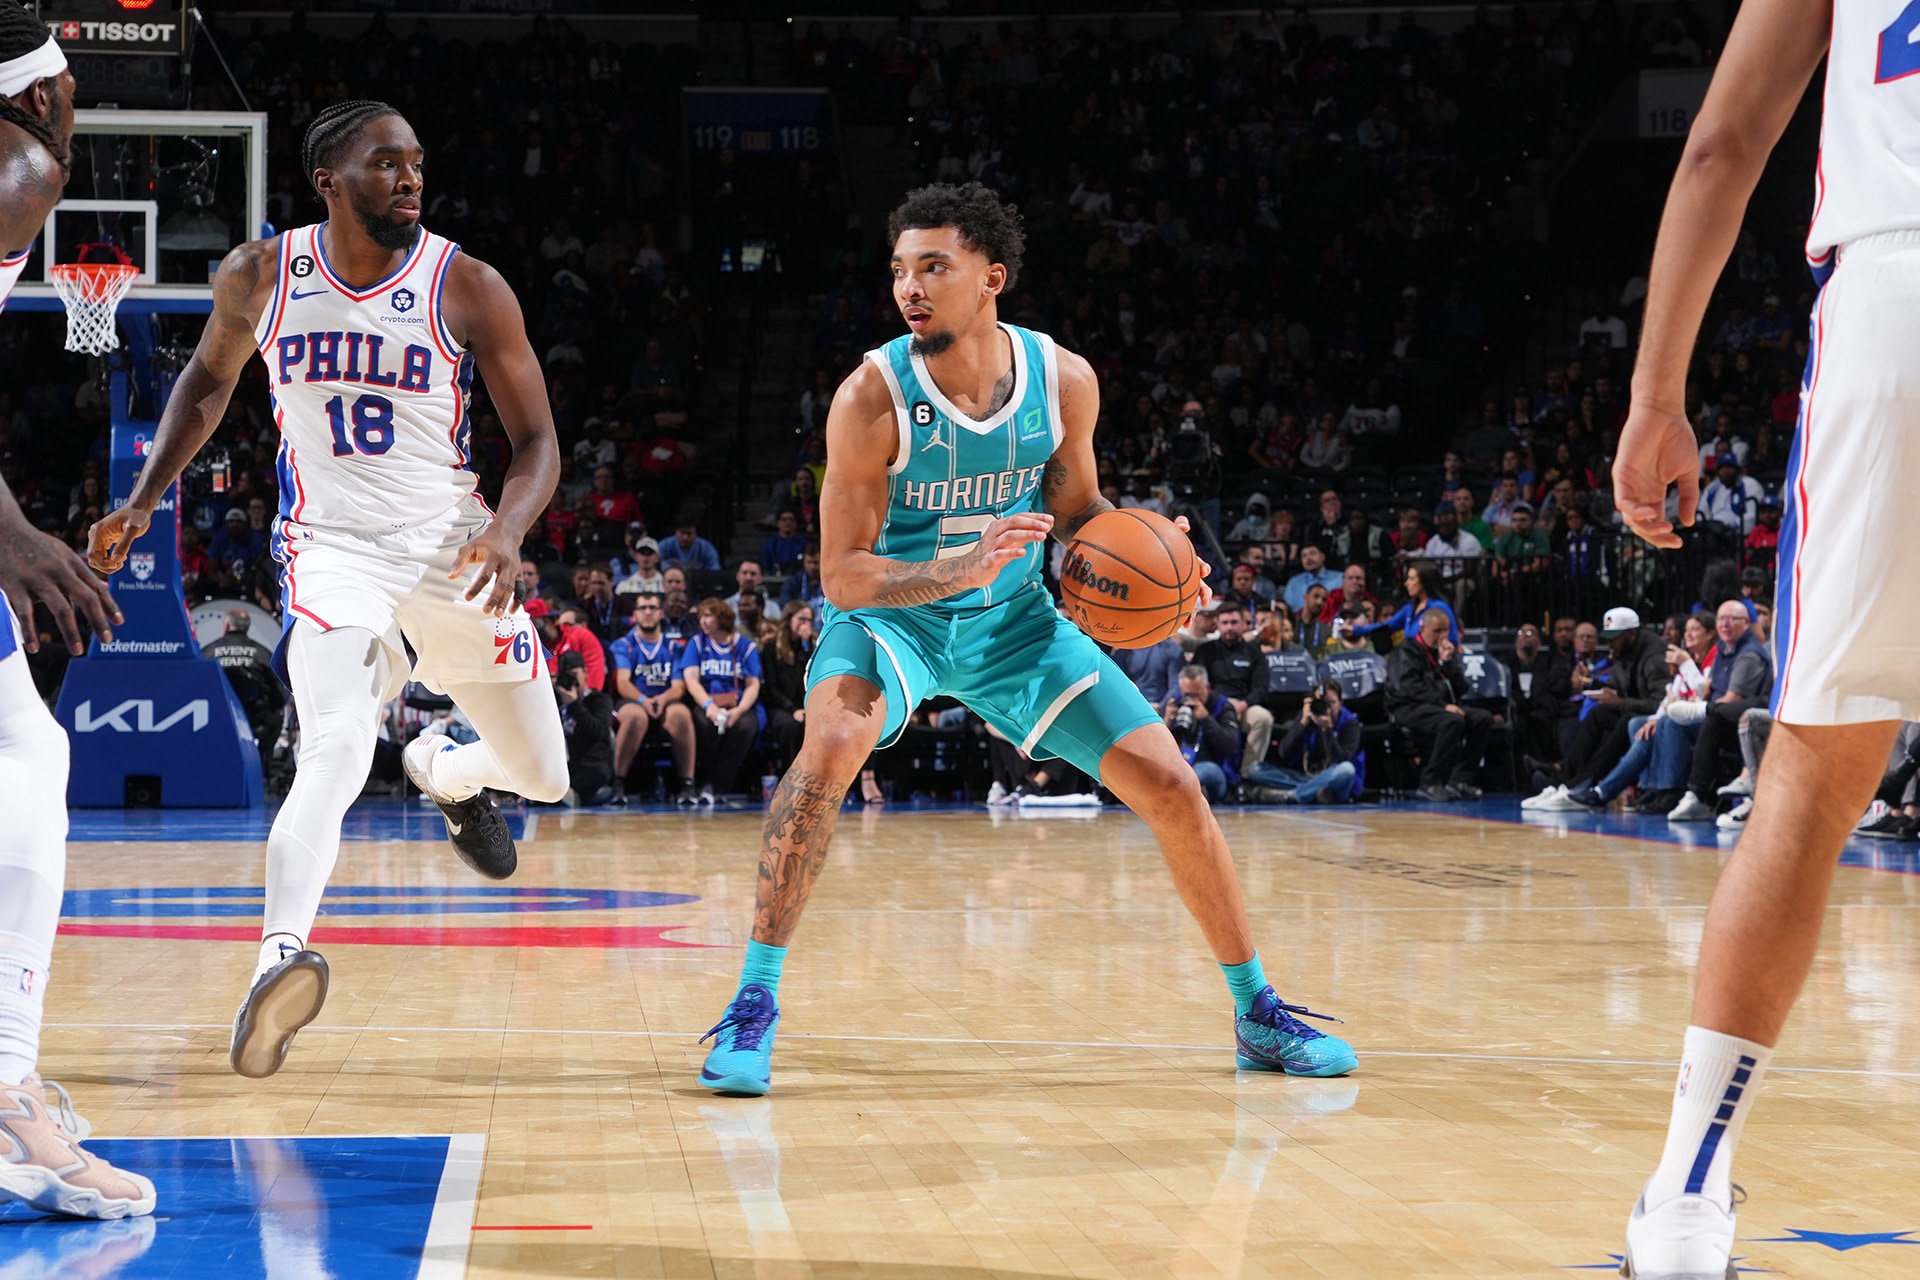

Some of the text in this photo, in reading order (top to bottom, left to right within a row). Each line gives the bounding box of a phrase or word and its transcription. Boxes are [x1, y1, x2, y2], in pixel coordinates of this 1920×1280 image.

[81, 22, 176, 42] TISSOT
[1648, 108, 1688, 133] 118
[693, 125, 819, 150] 119 118
[294, 256, 310, 275] 6
[379, 315, 425, 325] crypto.com
[277, 331, 433, 393] PHILA
[325, 394, 396, 457] 18
[915, 403, 930, 424] 6
[903, 463, 1046, 512] HORNETS
[1062, 548, 1130, 602] Wilson
[100, 638, 180, 653] ticketmaster
[214, 645, 257, 657] EVENT
[494, 630, 532, 665] 76
[75, 699, 209, 732] KIA
[790, 788, 833, 817] NEVER
[793, 810, 820, 833] DIE
